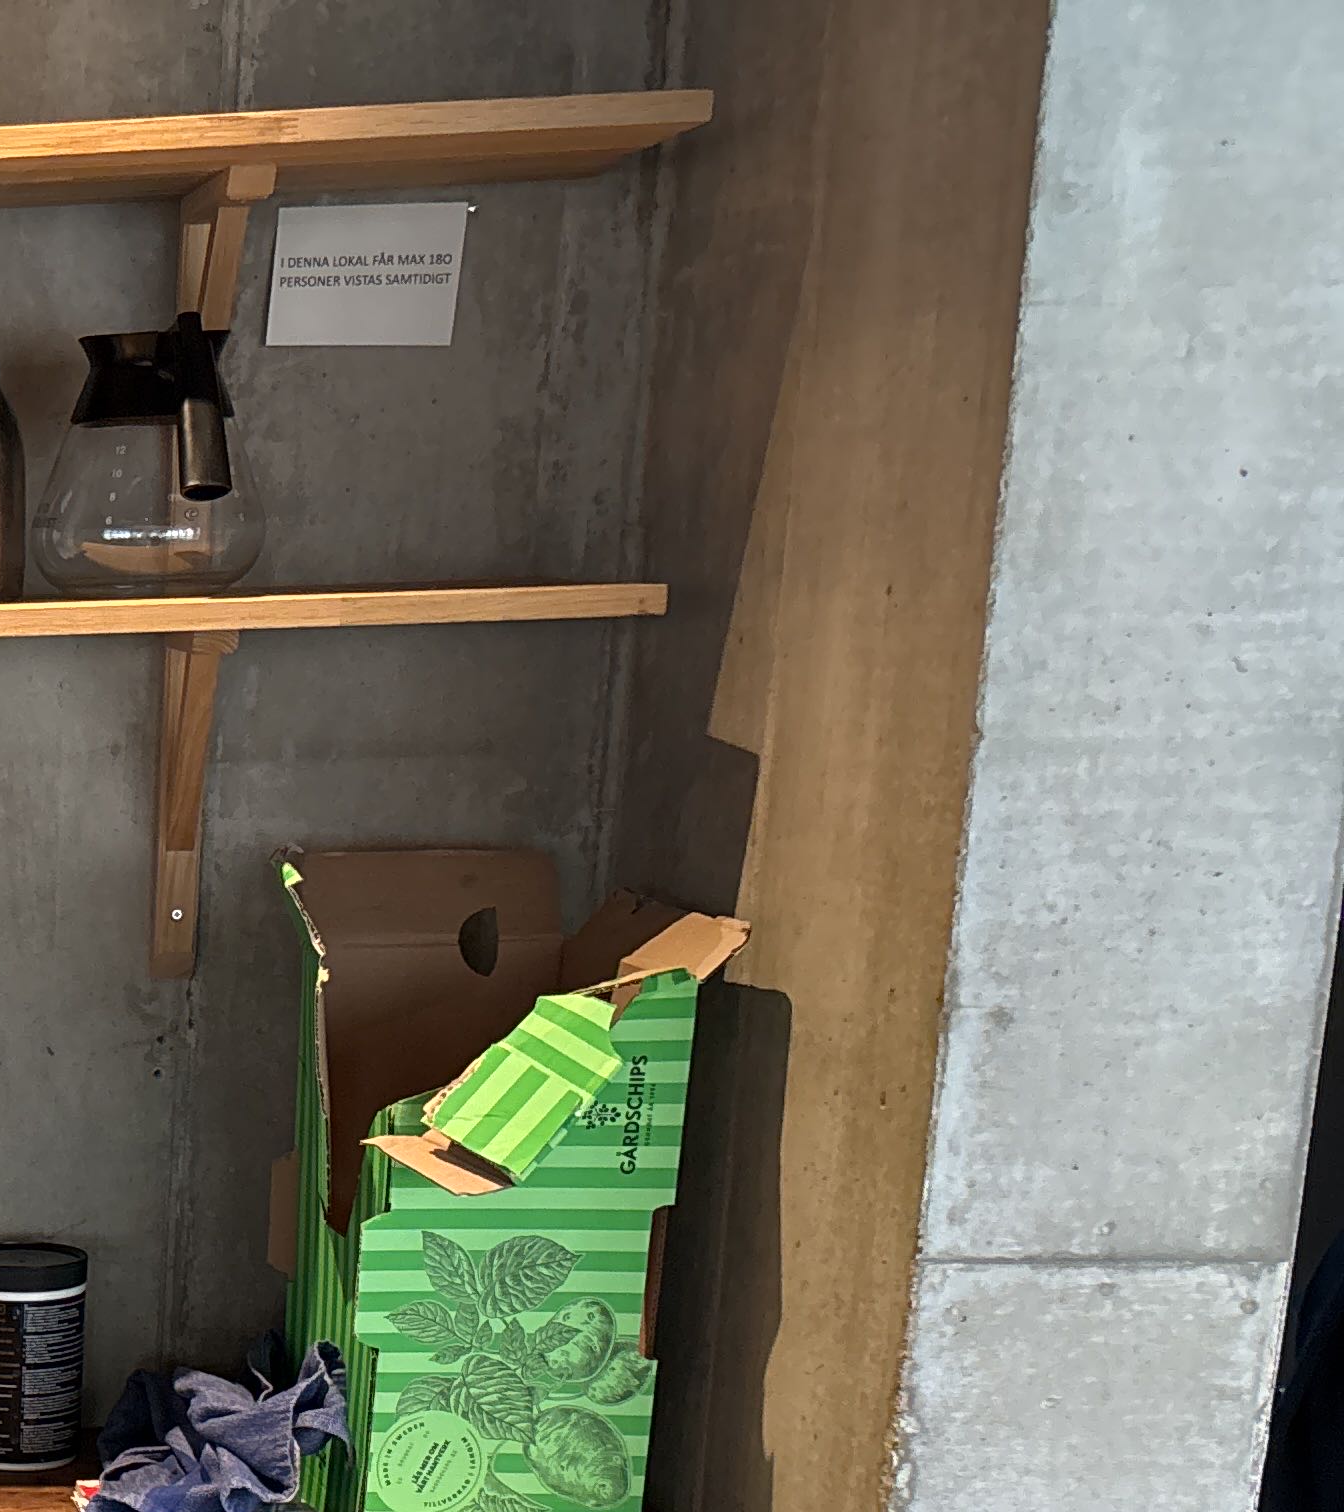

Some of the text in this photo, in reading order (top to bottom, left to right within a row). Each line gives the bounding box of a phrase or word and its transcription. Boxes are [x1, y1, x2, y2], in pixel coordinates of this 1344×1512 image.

[288, 256, 329, 268] DENNA
[332, 255, 369, 268] LOKAL
[372, 252, 394, 266] FÅR
[397, 254, 425, 266] MAX
[429, 253, 453, 266] 180
[279, 272, 452, 288] PERSONER VISTAS SAMTIDIGT
[115, 445, 127, 455] 12
[111, 468, 123, 478] 10
[105, 515, 113, 525] 6
[616, 1055, 648, 1175] GÅRDSCHIPS
[392, 1421, 425, 1446] SWEDEN
